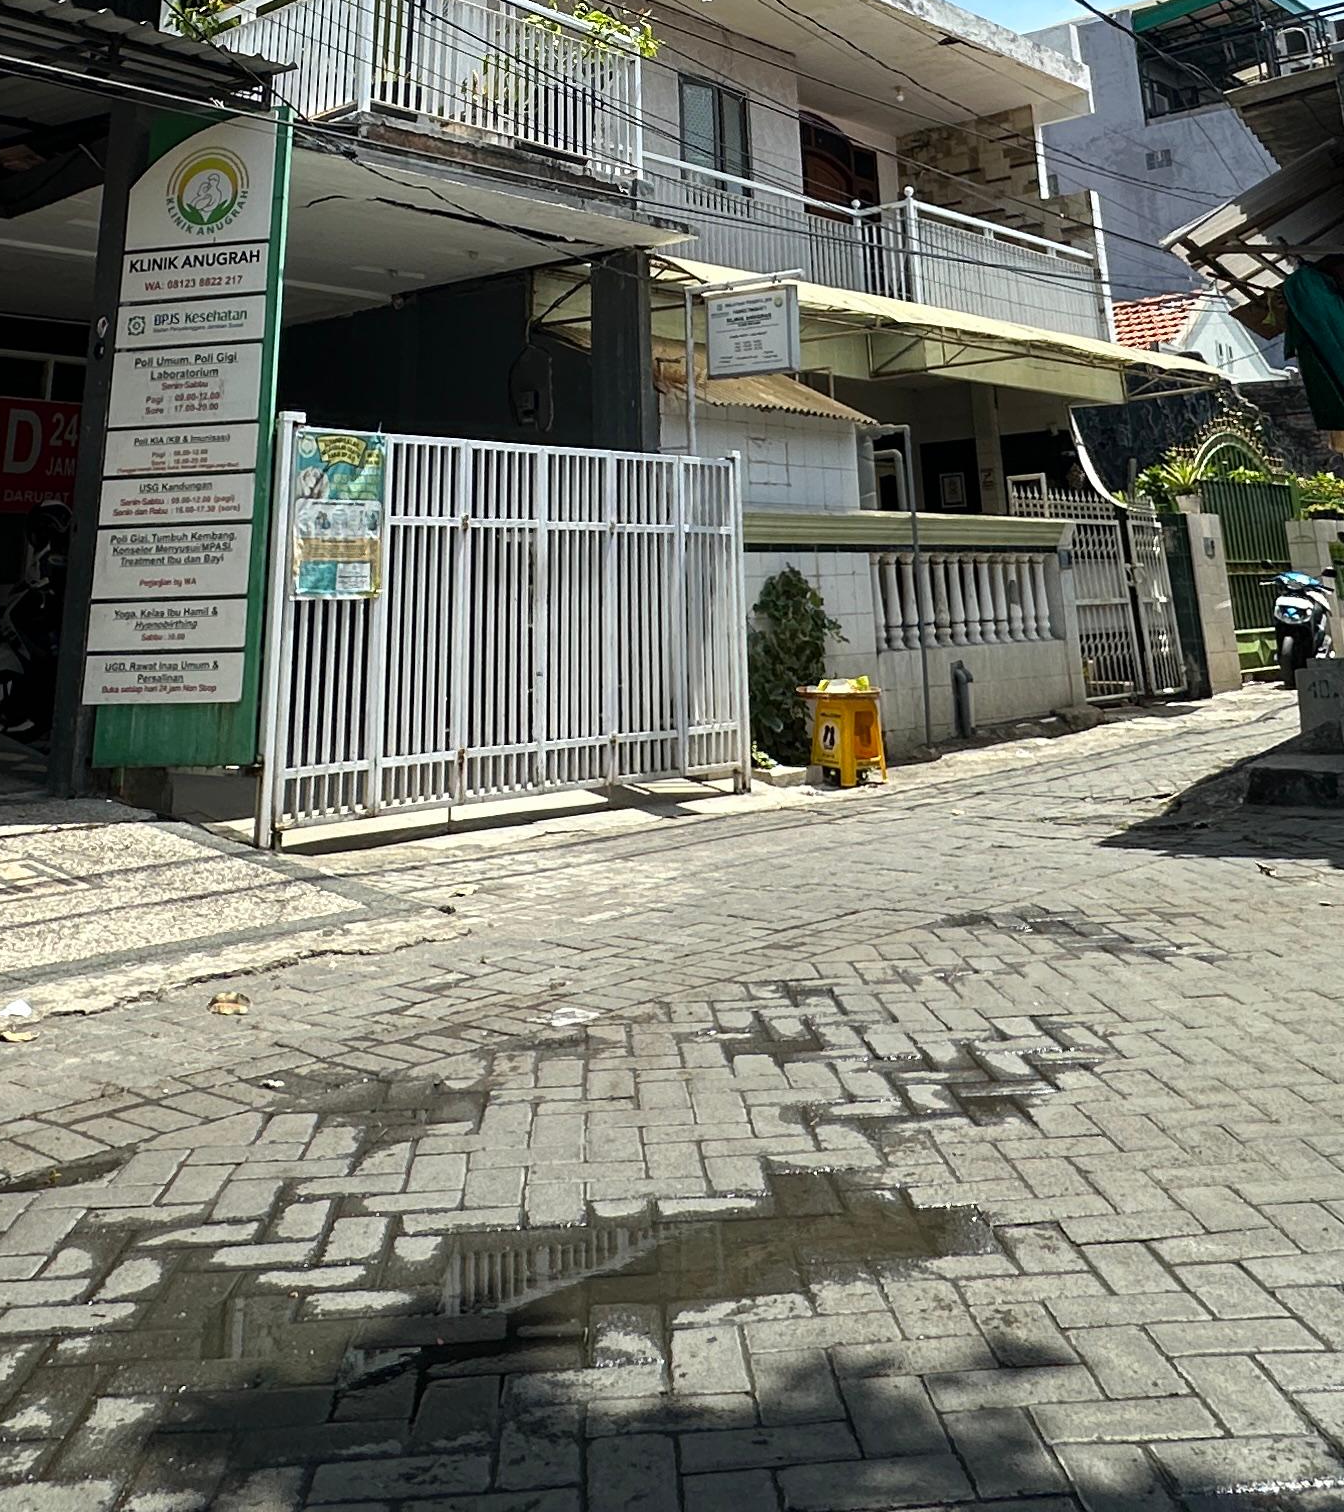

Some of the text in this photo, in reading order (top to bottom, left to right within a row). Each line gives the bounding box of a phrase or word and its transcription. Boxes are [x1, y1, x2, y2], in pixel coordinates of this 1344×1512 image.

[165, 190, 249, 235] KLINIK ANUGRAH
[129, 249, 260, 274] KLINIK ANUGRAH
[167, 278, 196, 289] 08123
[225, 275, 243, 285] 217
[154, 309, 248, 326] BPJS Kesehatan
[135, 356, 154, 368] Poli
[194, 353, 214, 364] Poli
[216, 352, 238, 365] Gigi
[150, 367, 219, 381] Laboratorium
[146, 395, 164, 405] Pagi
[49, 412, 79, 448] 24
[45, 456, 76, 477] JAM
[139, 481, 213, 493] USG Kandungan
[110, 534, 128, 545] Poli
[152, 532, 188, 543] Tumbuh
[121, 555, 165, 566] Treatment
[183, 554, 201, 564] dan
[204, 554, 224, 565] Bayi
[129, 662, 157, 672] Rawat
[181, 660, 210, 670] Umum
[137, 673, 184, 683] Persalinan
